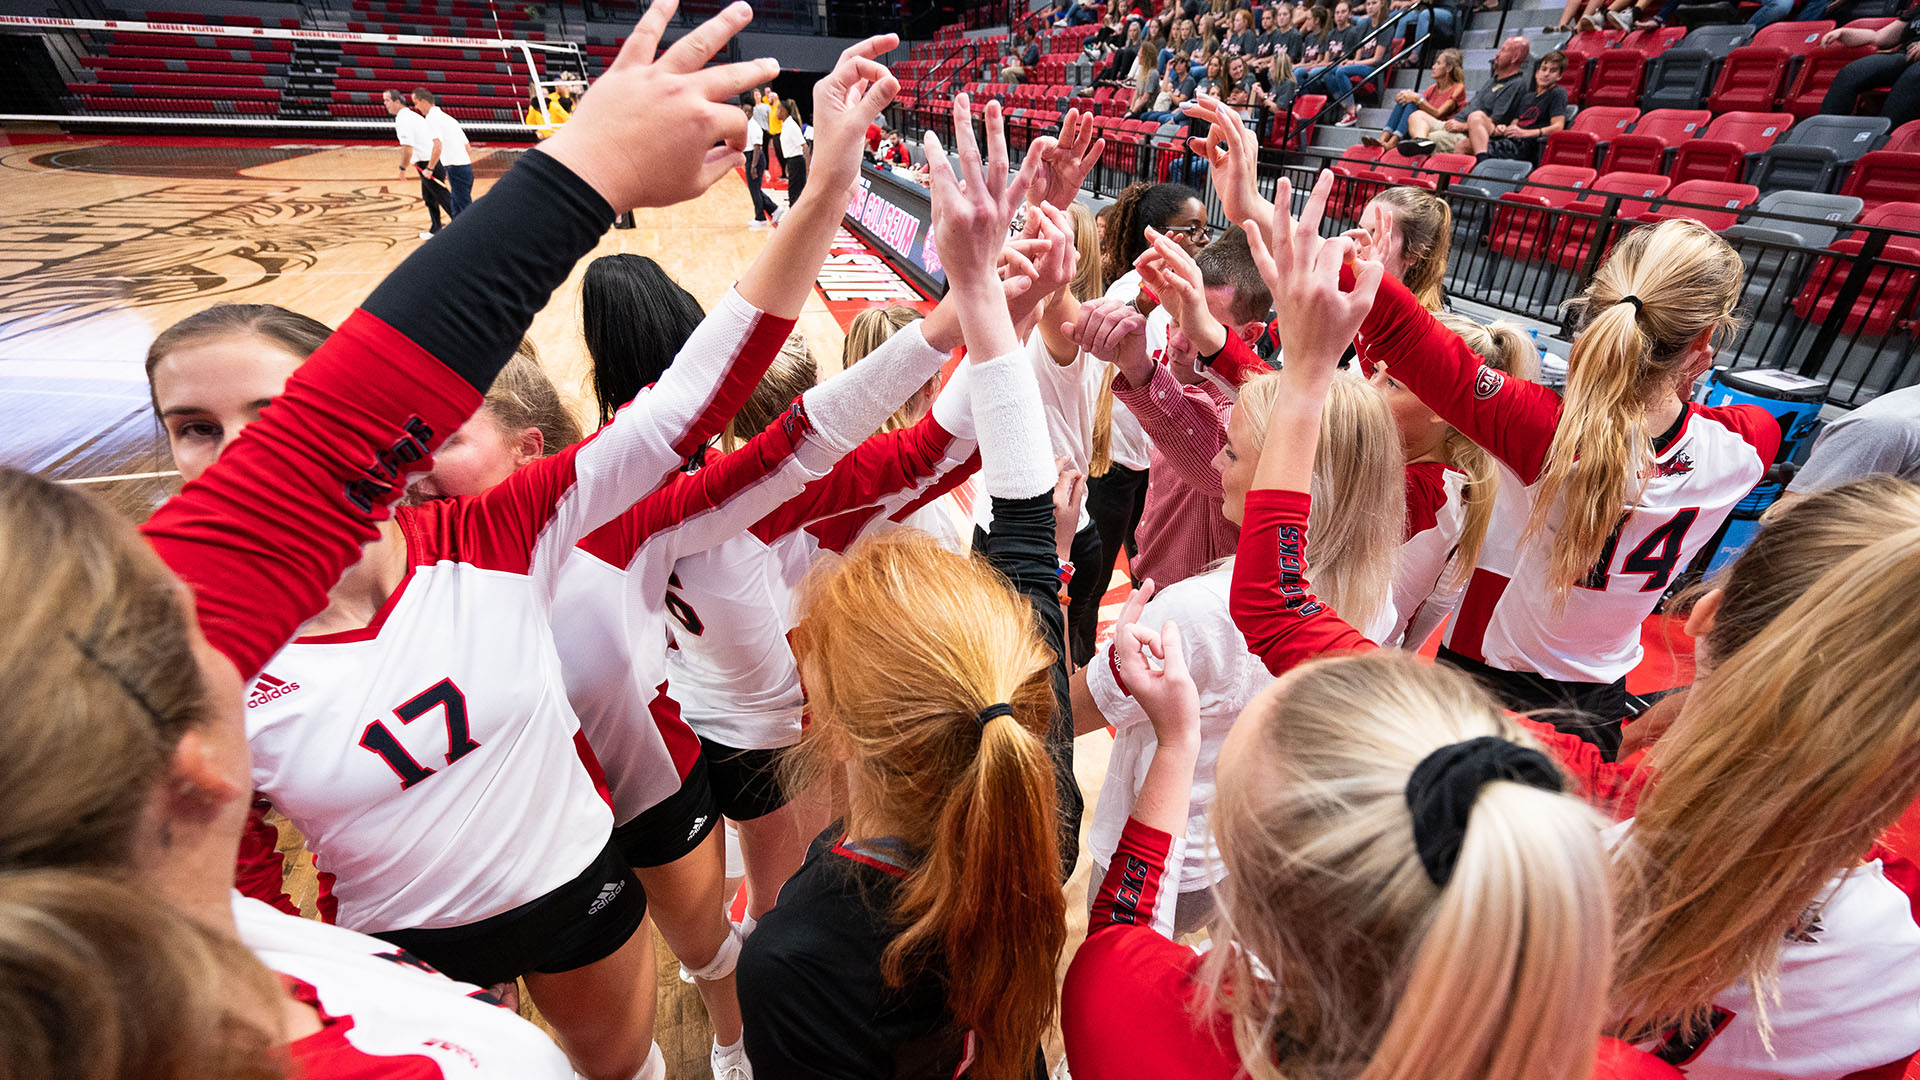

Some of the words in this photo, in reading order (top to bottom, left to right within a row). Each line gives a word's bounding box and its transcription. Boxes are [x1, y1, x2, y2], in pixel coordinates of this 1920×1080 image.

[862, 191, 920, 258] COLISEUM
[247, 681, 301, 709] adidas
[358, 676, 482, 791] 17
[587, 879, 626, 915] adidas
